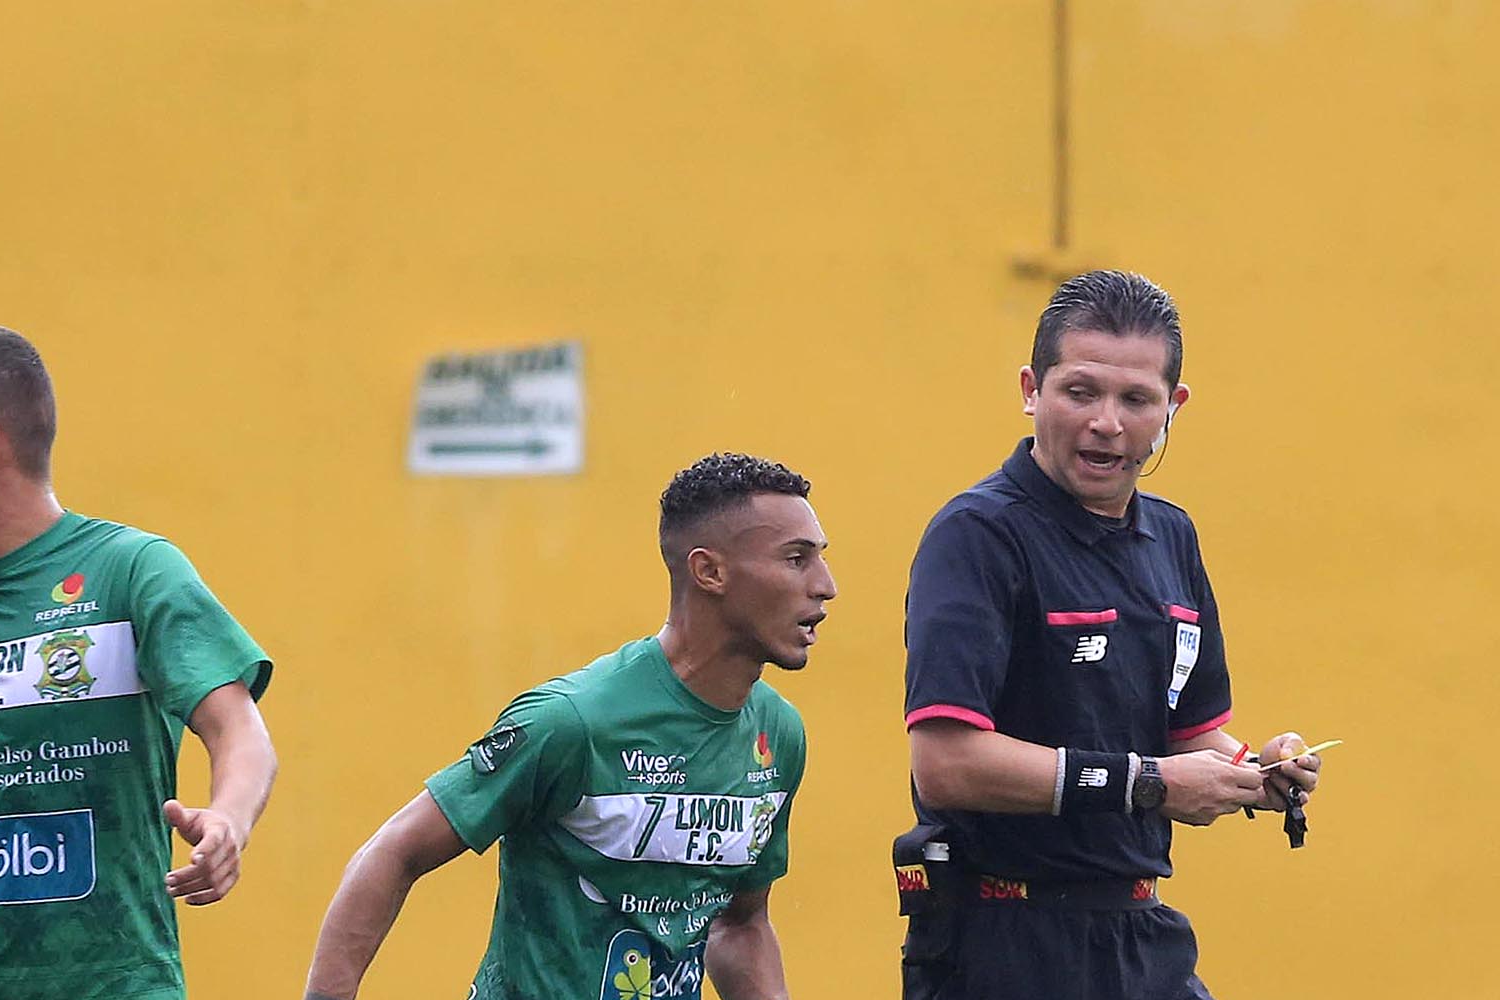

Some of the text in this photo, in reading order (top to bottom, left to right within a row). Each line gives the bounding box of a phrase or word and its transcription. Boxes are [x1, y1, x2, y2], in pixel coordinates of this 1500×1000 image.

[35, 600, 100, 622] REPRETEL
[39, 737, 130, 761] Gamboa
[621, 749, 669, 772] Vive
[675, 797, 744, 833] LIMON
[632, 796, 667, 859] 7
[686, 831, 723, 862] F.C.
[620, 893, 681, 914] Bufete
[657, 916, 671, 936] &
